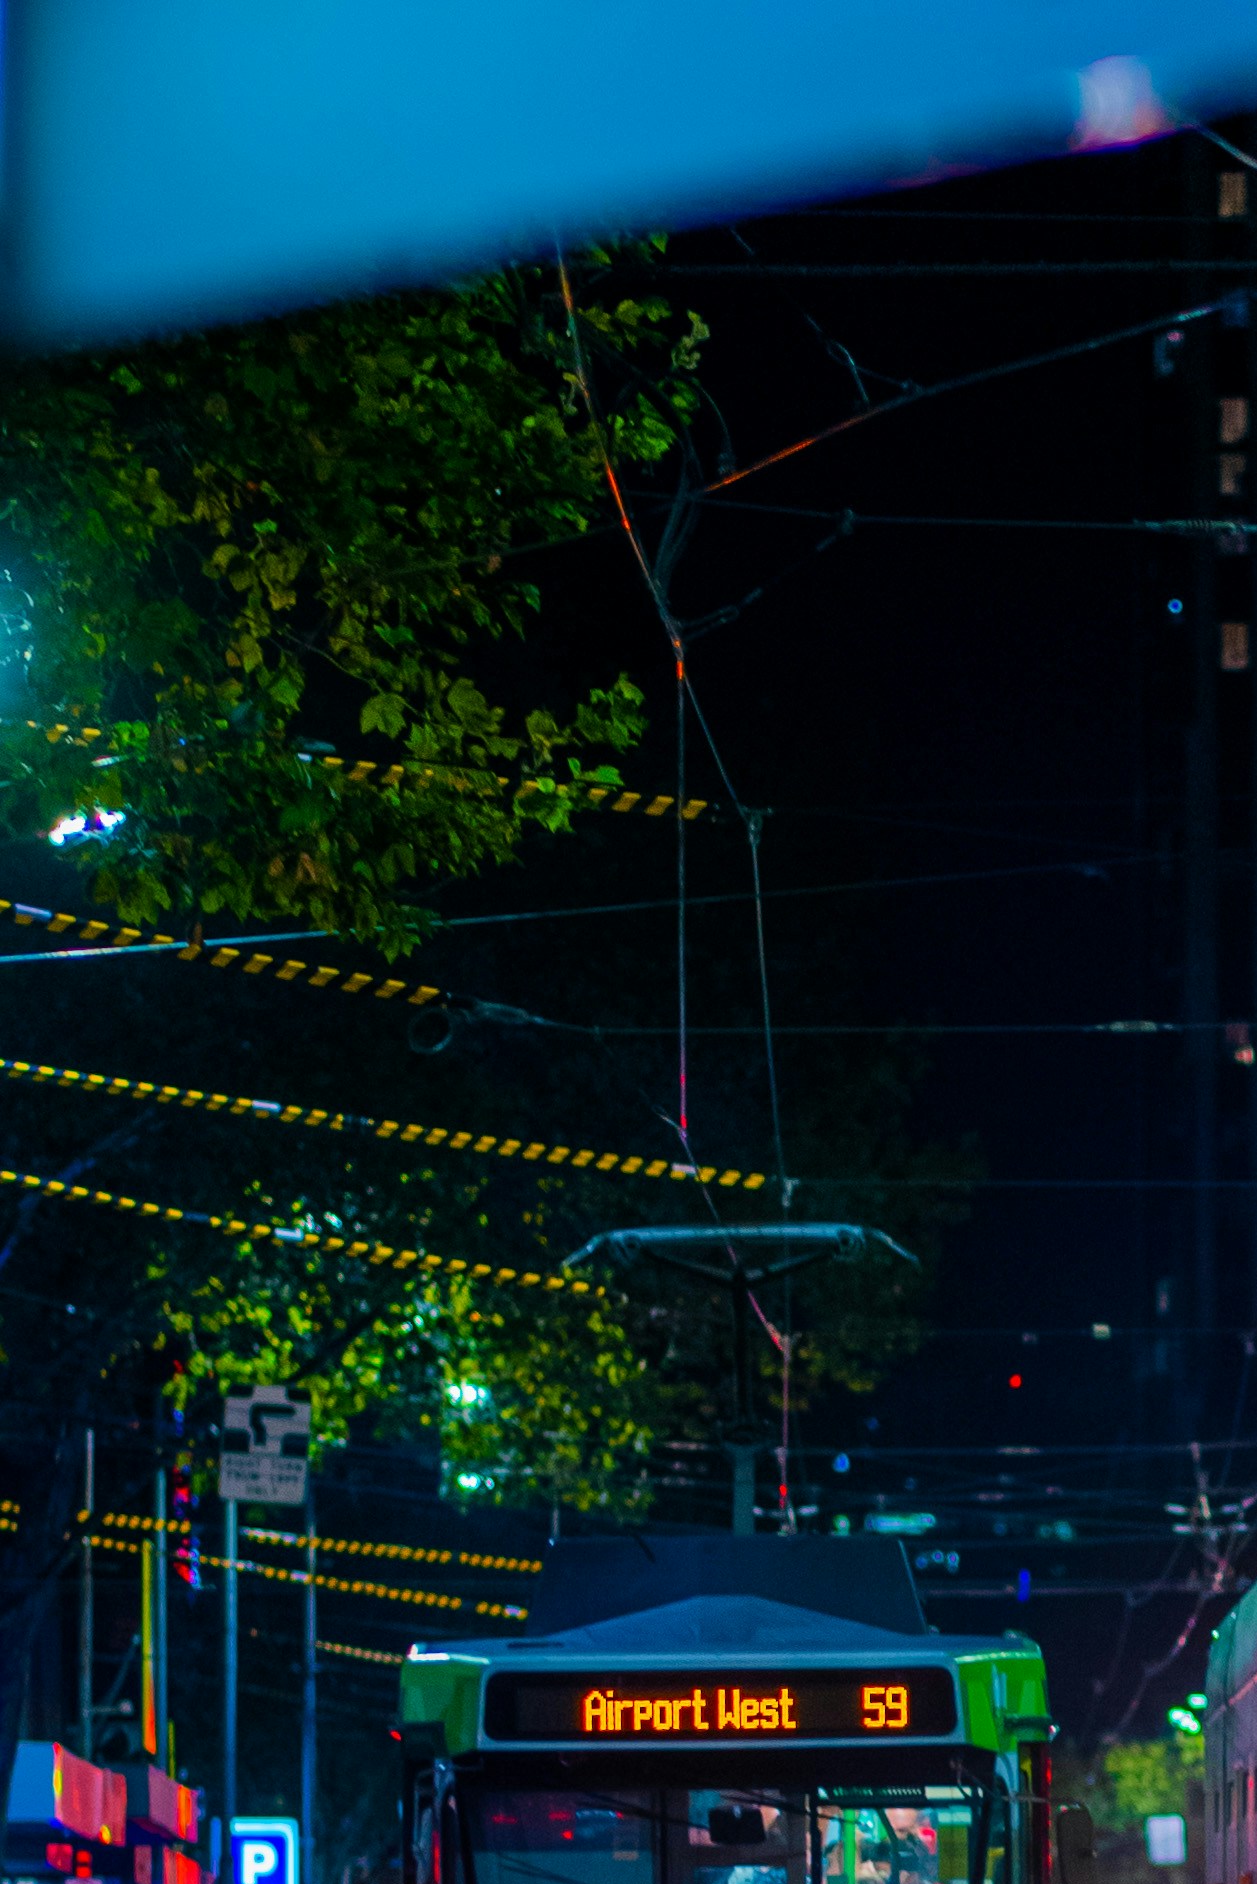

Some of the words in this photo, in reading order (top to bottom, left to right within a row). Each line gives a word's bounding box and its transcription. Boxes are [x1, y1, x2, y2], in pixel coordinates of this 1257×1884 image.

[585, 1688, 709, 1731] Airport
[718, 1688, 797, 1729] West
[862, 1686, 908, 1728] 59
